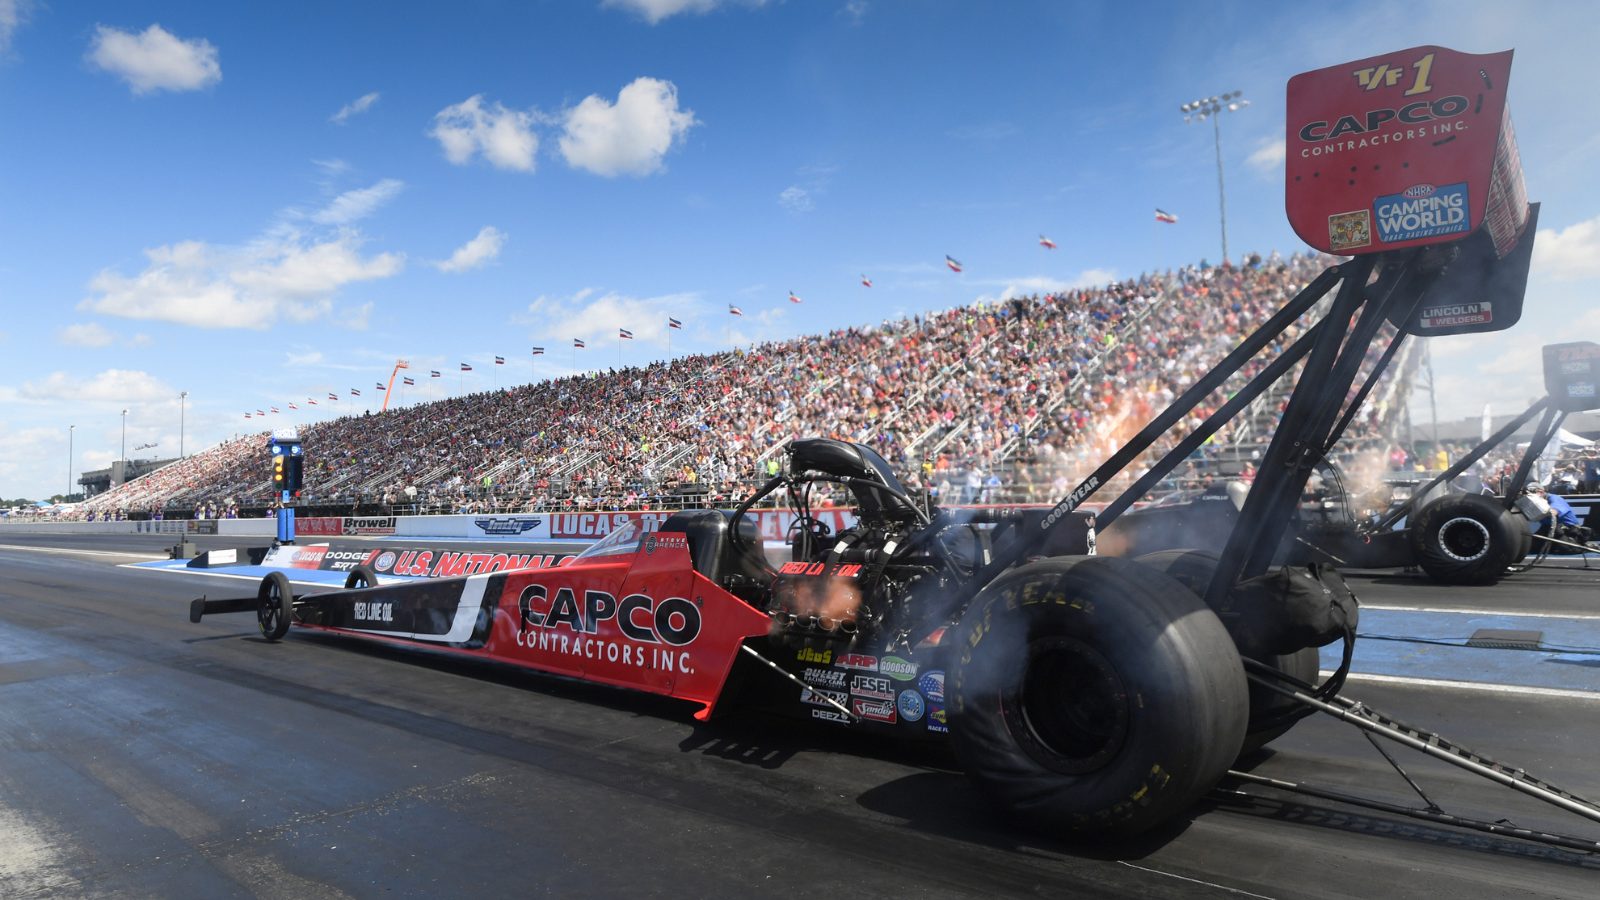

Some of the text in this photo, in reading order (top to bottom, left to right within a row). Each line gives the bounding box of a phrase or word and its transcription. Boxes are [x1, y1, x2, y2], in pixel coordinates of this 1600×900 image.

[1353, 53, 1435, 96] T/F 1
[1299, 95, 1469, 142] CAPCO
[1301, 120, 1469, 158] CONTRACTORS INC.
[1406, 186, 1432, 196] NHRA
[1378, 193, 1463, 218] CAMPING
[1380, 208, 1464, 234] WORLD
[1423, 305, 1478, 318] LINCOLN
[1435, 315, 1485, 325] WELDERS
[1041, 476, 1099, 529] GOODYEAR
[343, 518, 397, 528] Browell
[487, 519, 524, 534] Indy
[552, 513, 630, 536] LUCAS
[325, 552, 371, 560] DODGE
[393, 550, 434, 577] U.S.
[331, 562, 359, 571] SRT
[354, 602, 394, 622] RED LINE OIL
[518, 584, 702, 646] CAPCO
[516, 629, 695, 675] CONTRACTORS INC.
[835, 654, 877, 668] ARP
[881, 661, 917, 675] GOODSON
[851, 675, 894, 694] JESEL
